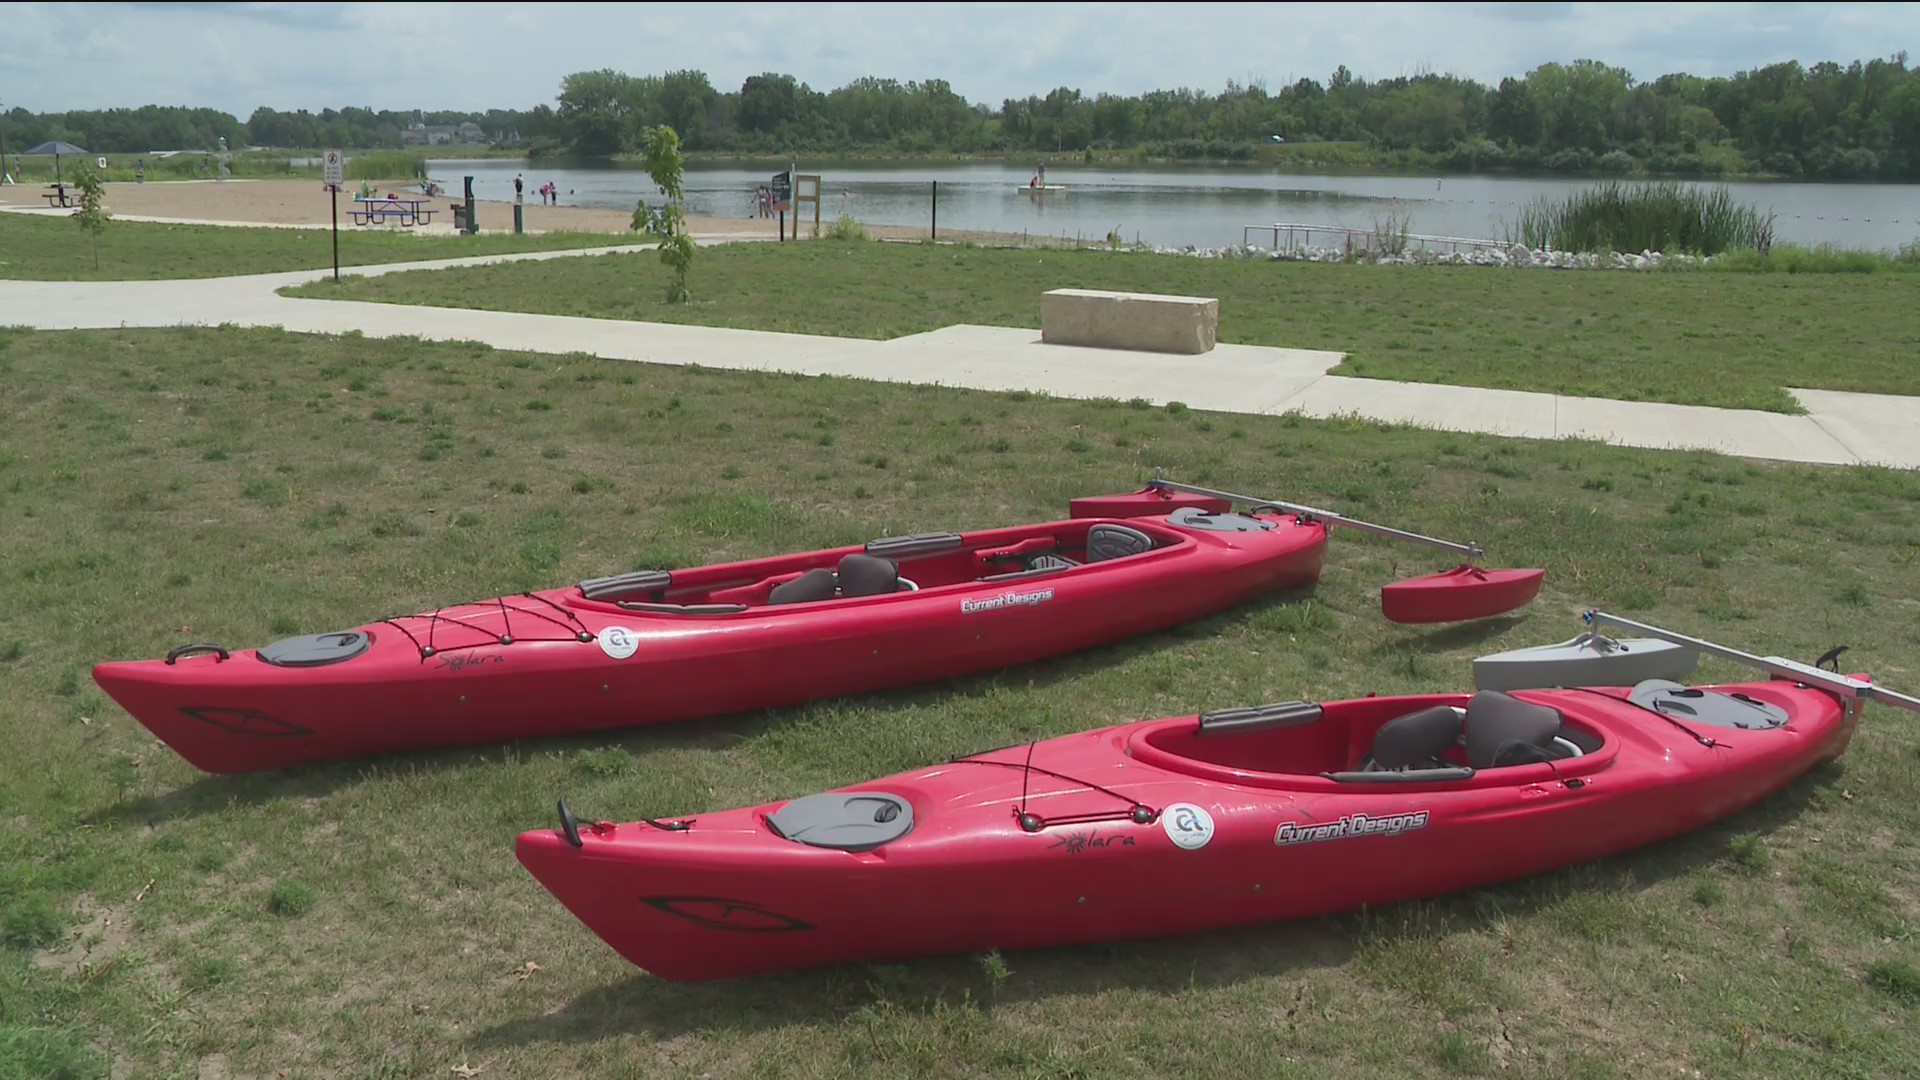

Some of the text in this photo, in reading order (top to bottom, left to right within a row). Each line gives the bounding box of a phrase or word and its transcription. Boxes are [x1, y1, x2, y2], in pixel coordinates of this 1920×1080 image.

[961, 588, 1054, 613] Current Designs
[1275, 811, 1429, 845] Current Designs
